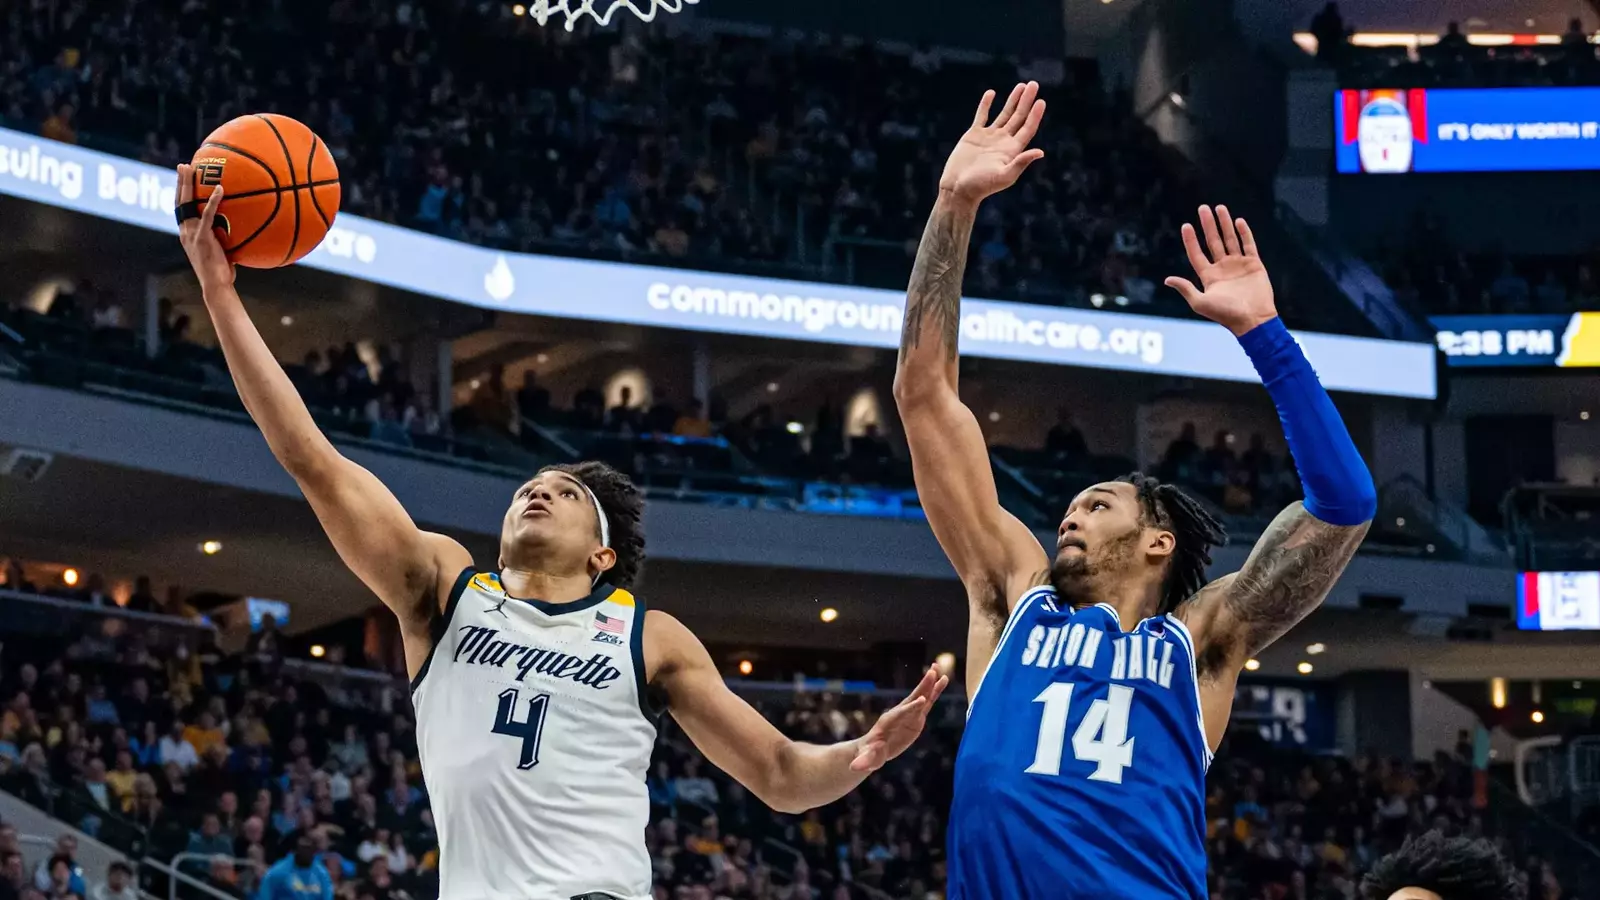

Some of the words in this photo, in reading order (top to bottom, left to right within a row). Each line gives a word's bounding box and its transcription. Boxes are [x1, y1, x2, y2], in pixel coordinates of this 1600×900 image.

[98, 163, 175, 215] Bette
[1506, 329, 1554, 354] PM
[453, 625, 621, 690] Marquette
[1110, 634, 1175, 689] HALL
[491, 688, 550, 770] 4
[1023, 681, 1135, 784] 14
